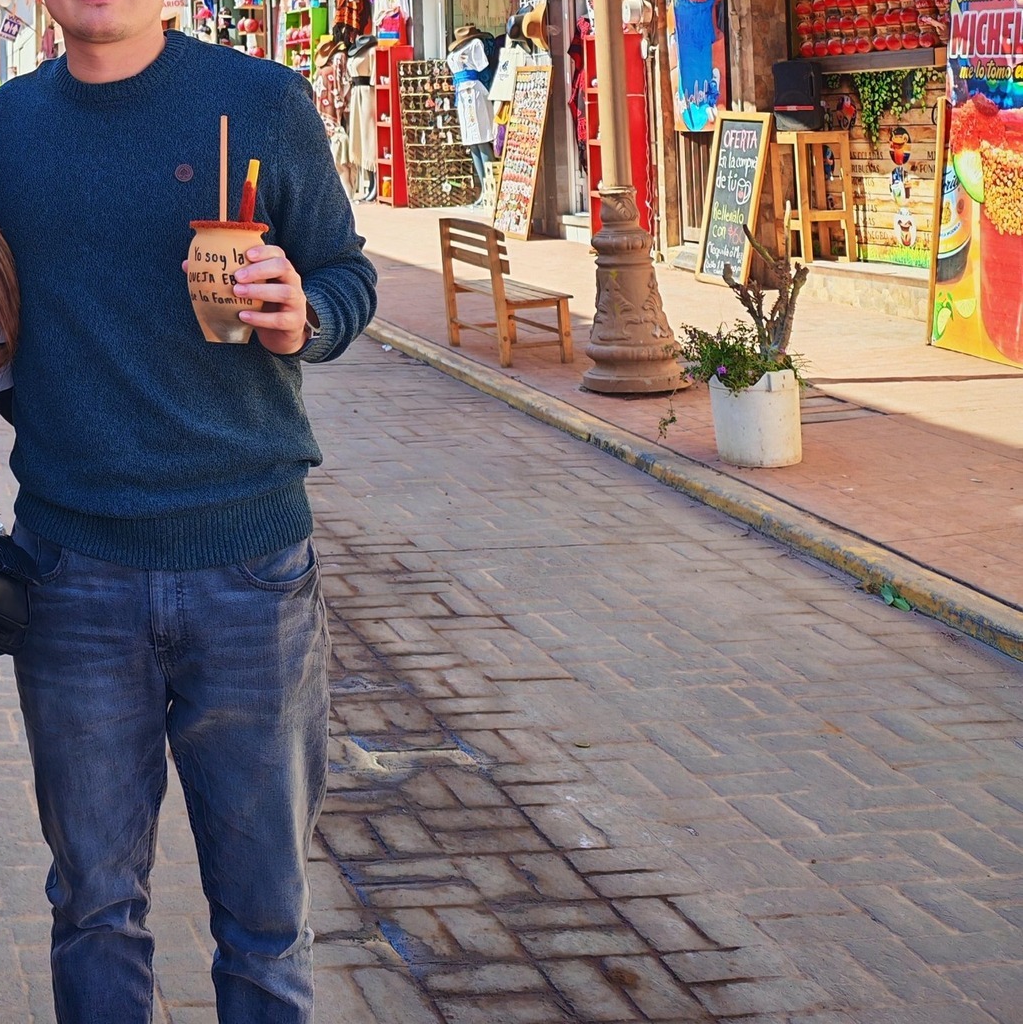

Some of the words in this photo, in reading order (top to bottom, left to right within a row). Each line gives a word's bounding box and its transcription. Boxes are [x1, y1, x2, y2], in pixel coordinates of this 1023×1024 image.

[959, 64, 975, 79] me
[976, 59, 986, 78] lo
[986, 59, 1013, 79] tomo
[723, 129, 758, 152] OFERTA
[728, 151, 737, 169] la
[716, 170, 727, 189] de
[205, 252, 227, 271] soy
[232, 247, 245, 266] la
[189, 271, 216, 284] OVEJA
[198, 289, 210, 303] la
